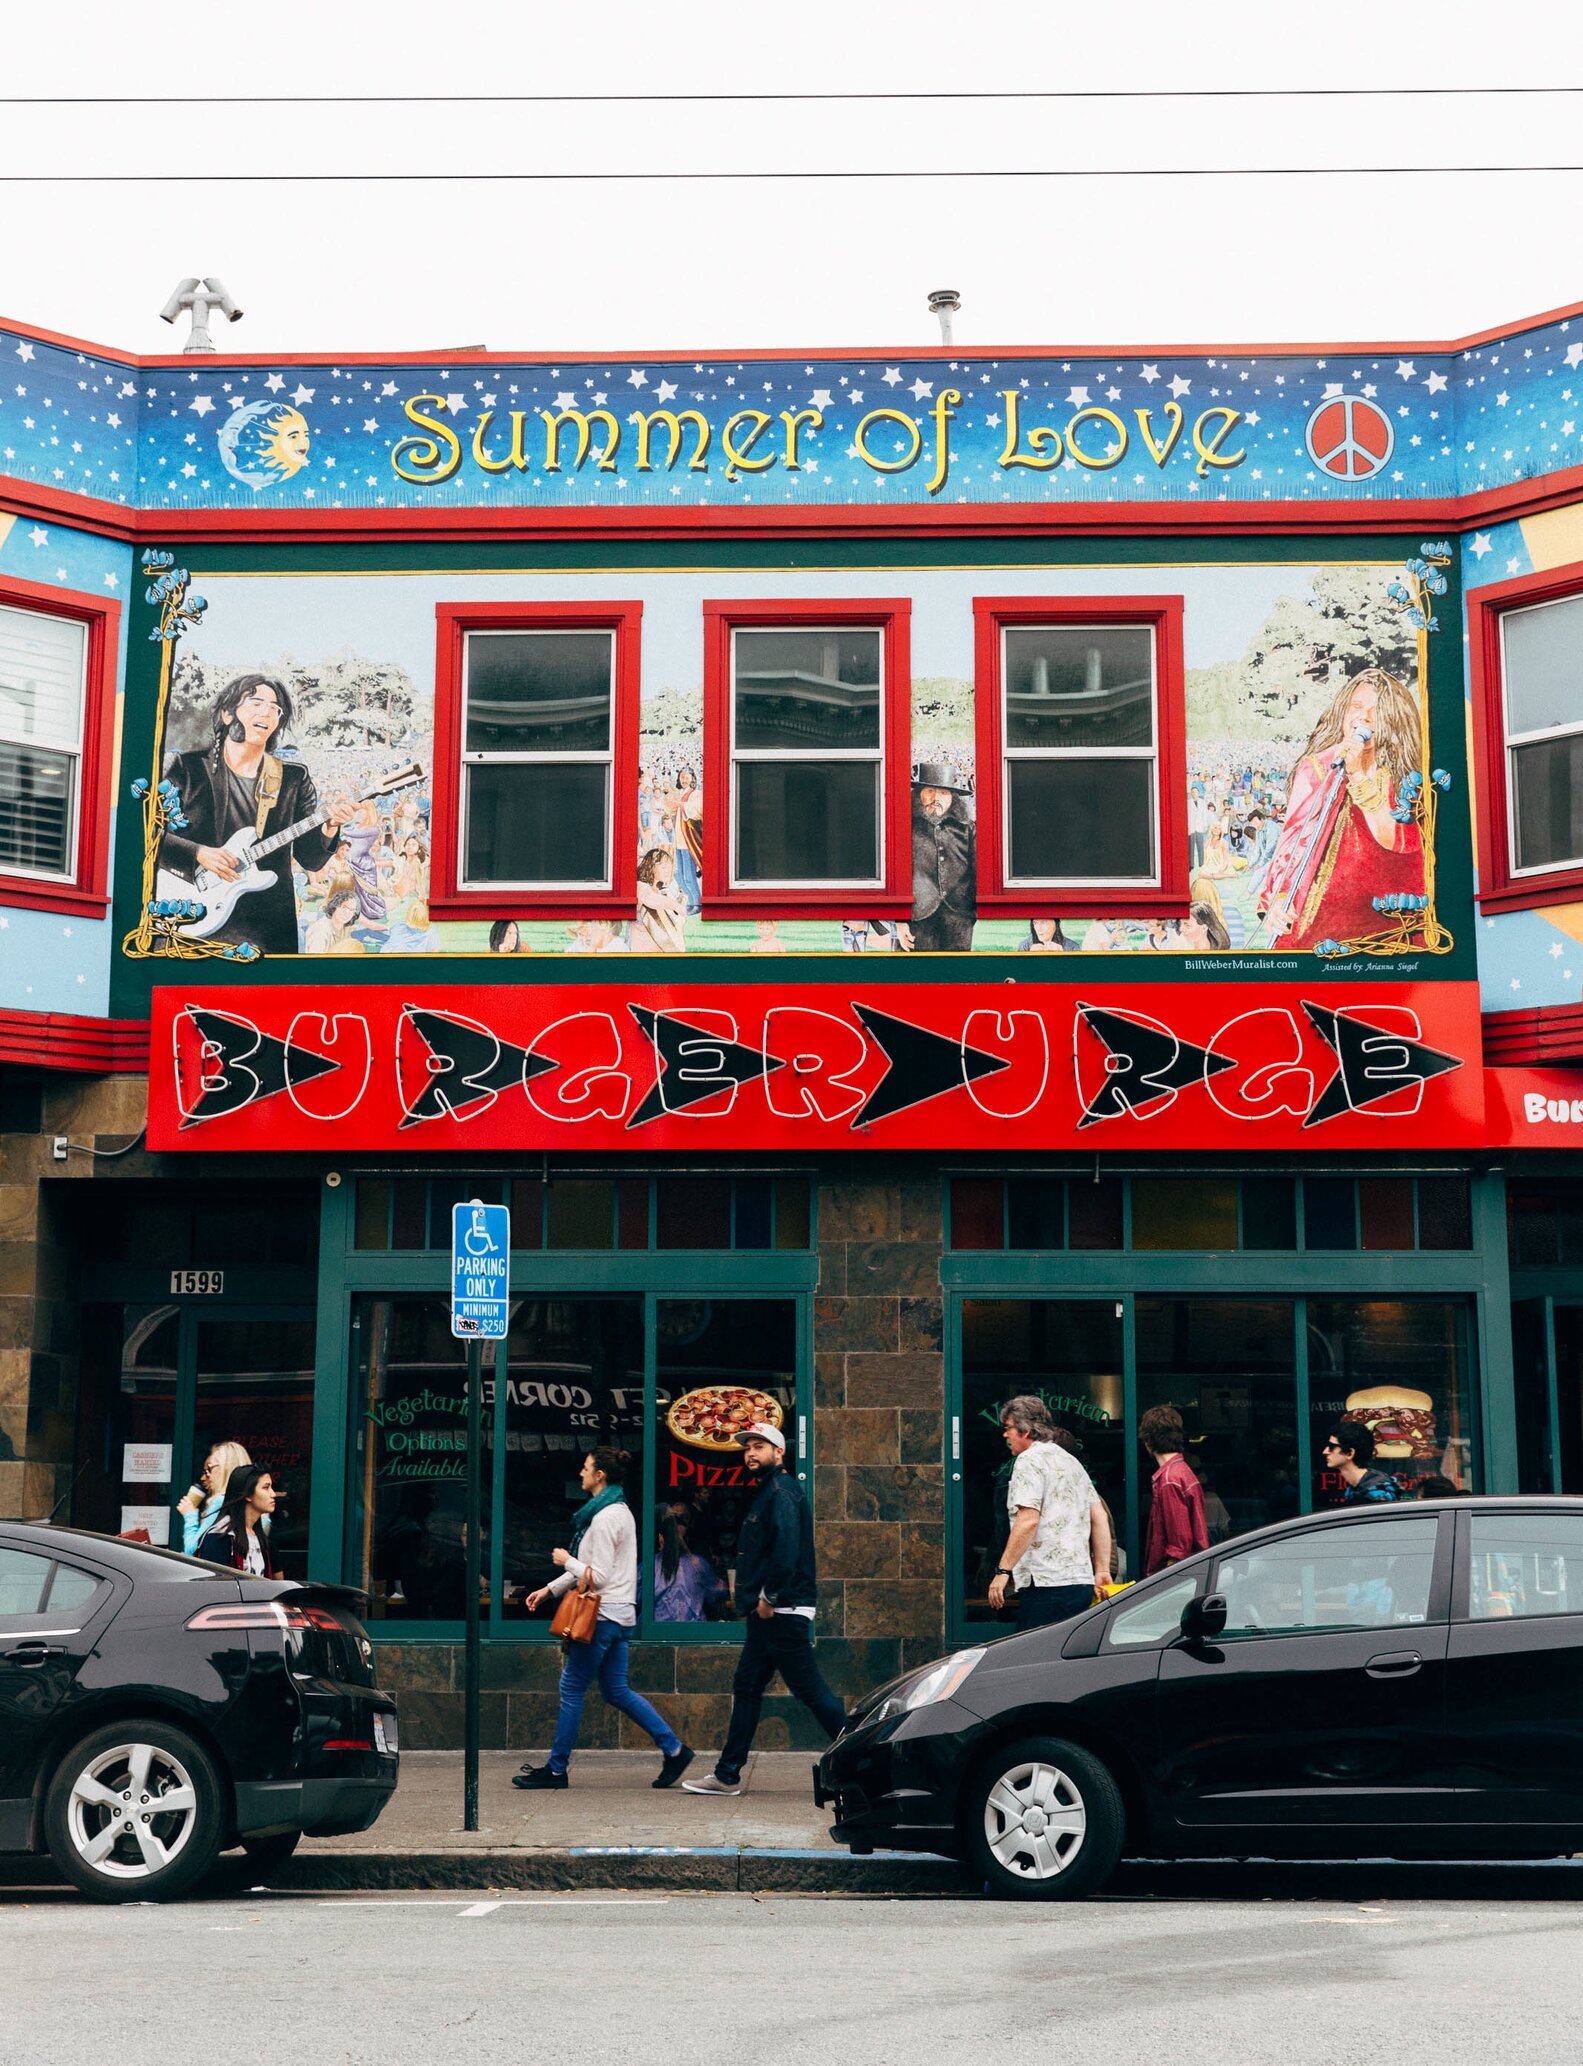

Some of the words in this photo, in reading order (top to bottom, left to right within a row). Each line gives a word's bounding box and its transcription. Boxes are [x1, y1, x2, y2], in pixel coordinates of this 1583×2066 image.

[392, 394, 824, 485] Summer
[855, 388, 963, 495] of
[998, 390, 1248, 476] Love
[1184, 959, 1299, 971] BillWeberMuralist.com
[1322, 963, 1351, 972] Assisted
[456, 1257, 506, 1277] PARKING
[173, 1272, 223, 1293] 1599
[466, 1277, 496, 1297] ONLY
[463, 1303, 499, 1317] MINIMUM
[482, 1319, 505, 1333] $250
[978, 1387, 1111, 1428] Vtarian
[388, 1432, 466, 1456] Options
[376, 1455, 469, 1477] Available
[668, 1448, 758, 1487] PIZZ
